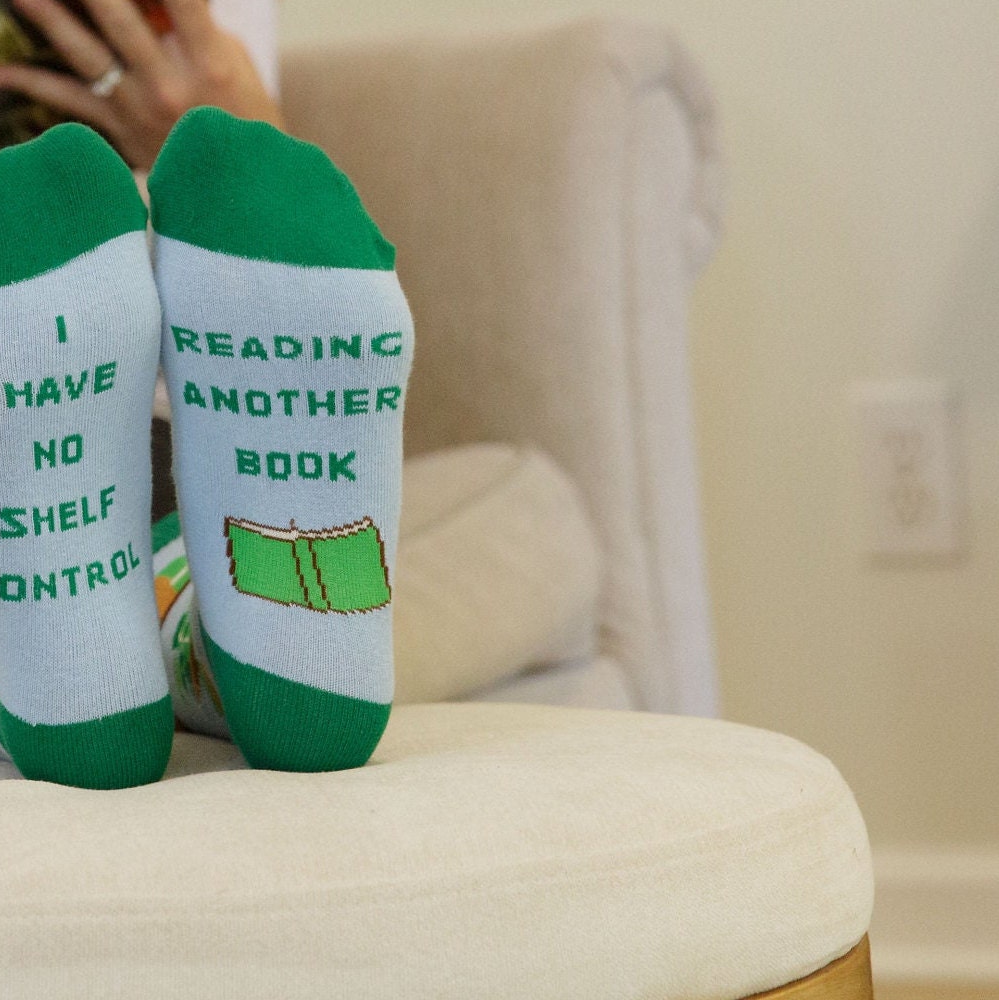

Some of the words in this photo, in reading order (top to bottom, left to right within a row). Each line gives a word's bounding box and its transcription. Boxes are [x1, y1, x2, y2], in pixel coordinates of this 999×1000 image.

[55, 315, 68, 343] I
[170, 325, 403, 361] READING
[3, 362, 117, 408] HAVE
[183, 381, 402, 418] ANOTHER
[33, 433, 84, 471] NO
[235, 448, 357, 482] BOOK
